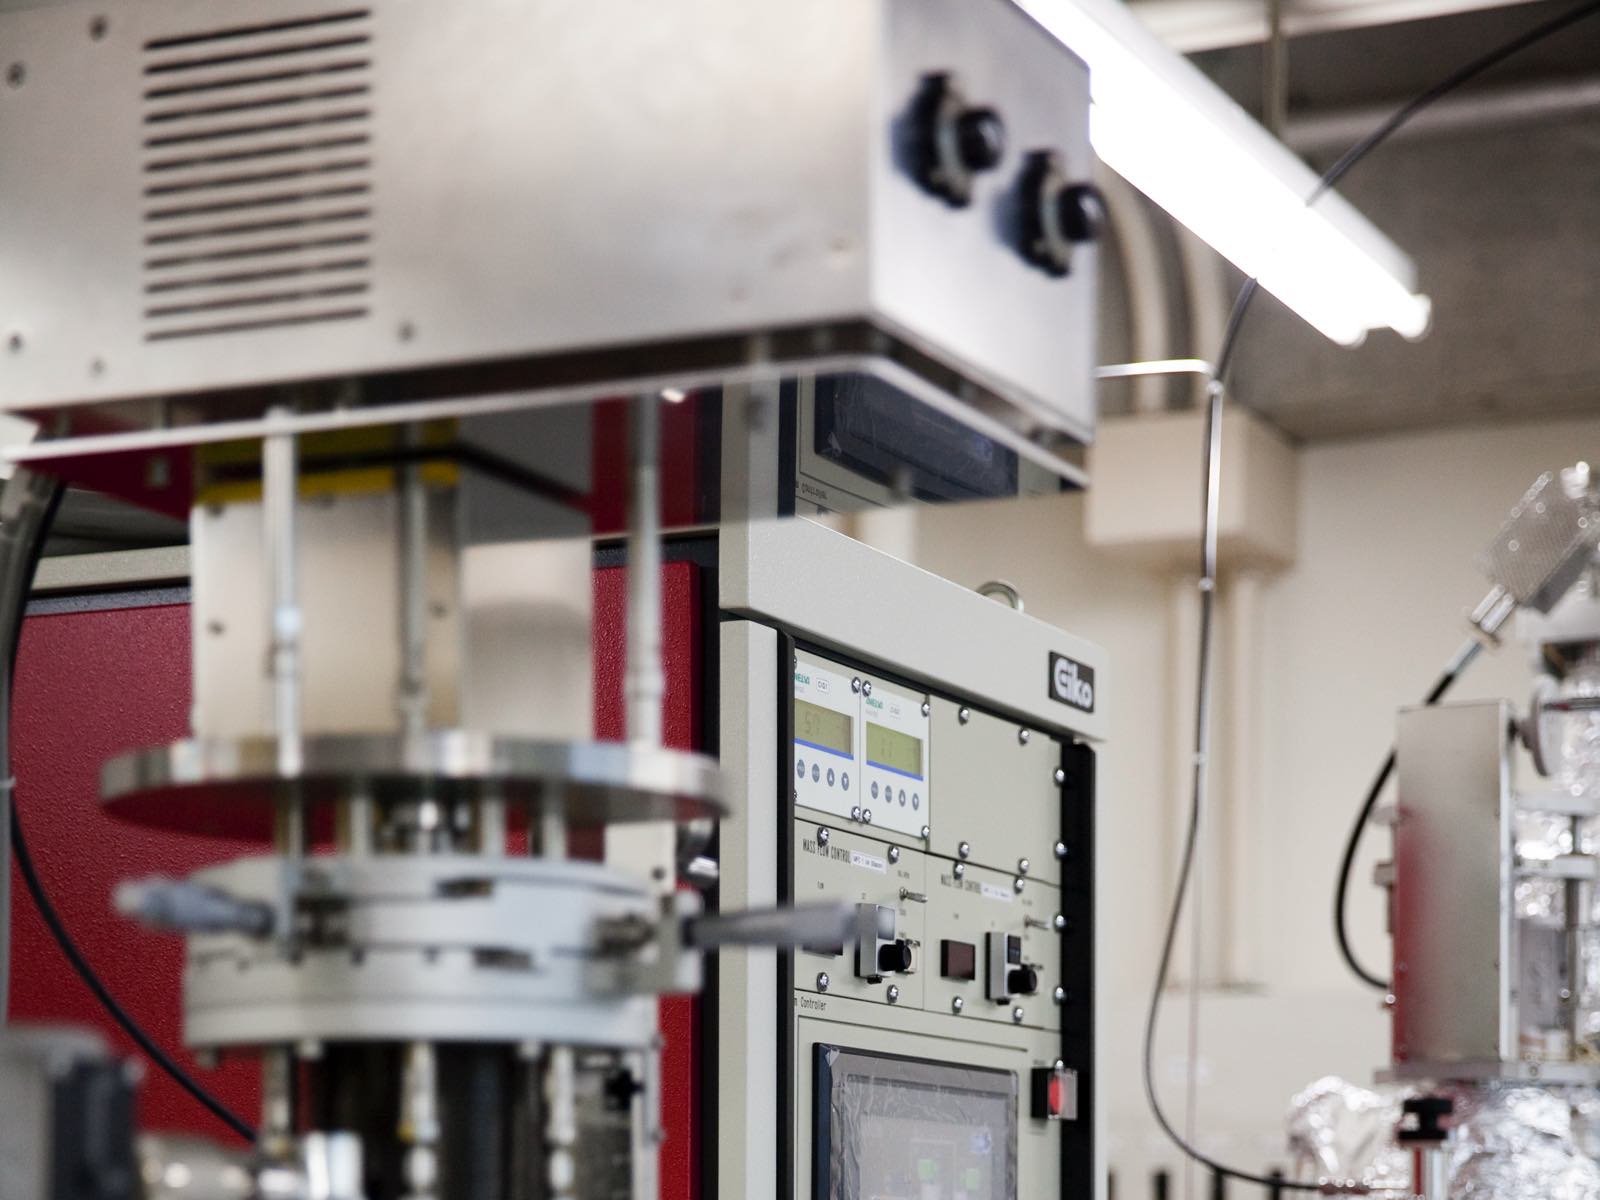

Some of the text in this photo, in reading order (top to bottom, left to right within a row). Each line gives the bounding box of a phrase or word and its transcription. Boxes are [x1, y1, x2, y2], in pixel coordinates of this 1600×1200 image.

[1054, 658, 1092, 708] Eiko
[802, 838, 817, 856] MASS
[830, 846, 852, 864] CONTROL
[800, 996, 826, 1011] Controller
